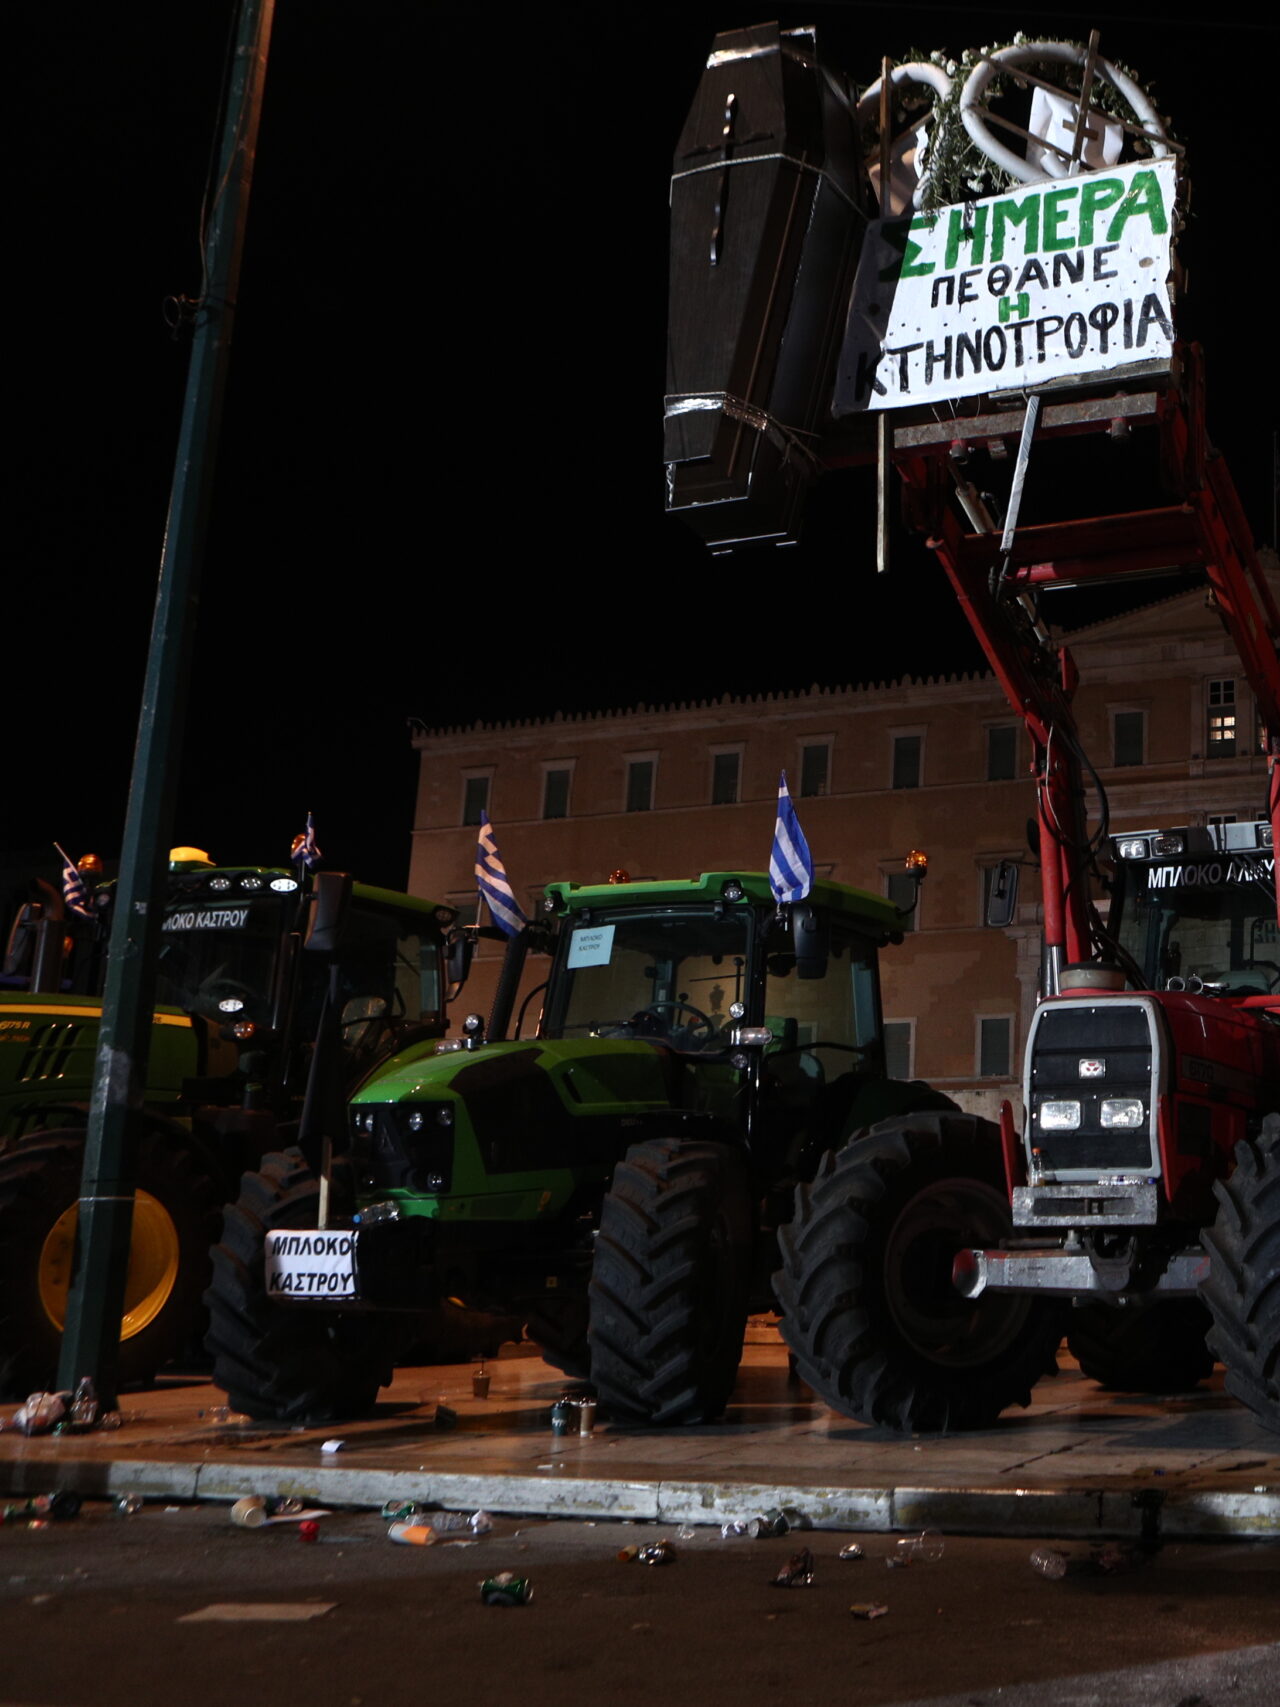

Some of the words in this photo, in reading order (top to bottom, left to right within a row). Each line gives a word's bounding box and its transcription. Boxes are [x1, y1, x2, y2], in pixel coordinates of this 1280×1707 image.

[879, 170, 1168, 283] ΣΗΜΕΡΑ
[931, 244, 1119, 308] ΠΕΘΑΝΕ
[999, 293, 1030, 322] Η
[855, 293, 1172, 401] ΚΤΗΝΟΤΡΟΦΙΑ
[1148, 863, 1222, 889] ΜΠΛΟΚΟ
[162, 912, 194, 931] ΛΟΚΟ
[196, 908, 249, 928] ΚΑΣΤΡΟΥ
[272, 1236, 352, 1256] ΜΠΛΟΚΟ
[269, 1272, 354, 1292] ΚΑΣΤΡΟΥ
